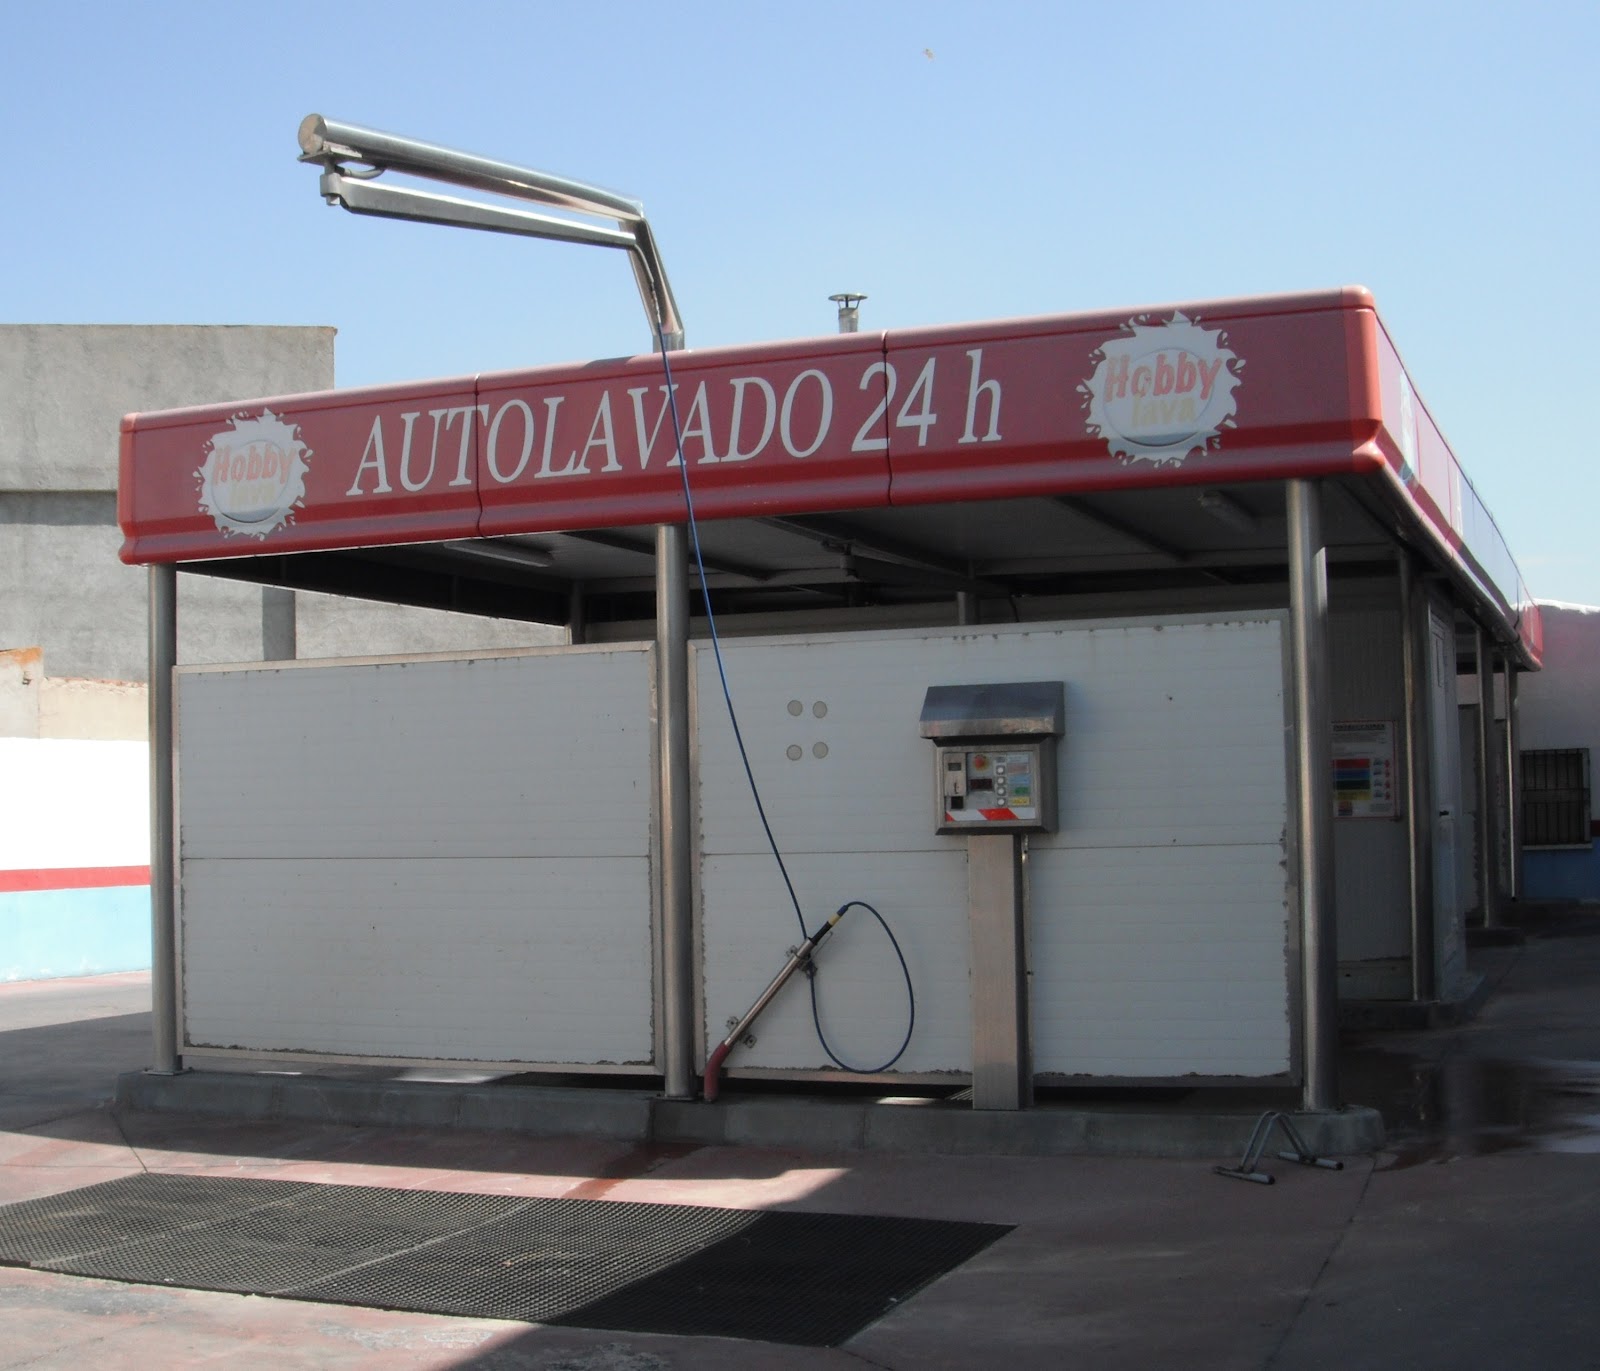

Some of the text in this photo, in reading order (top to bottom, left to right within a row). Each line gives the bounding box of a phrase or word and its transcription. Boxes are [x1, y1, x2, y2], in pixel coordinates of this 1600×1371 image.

[1104, 351, 1223, 403] Hobby
[345, 348, 1002, 496] AUTOLAVADO 24 h
[212, 443, 297, 486] Hobby
